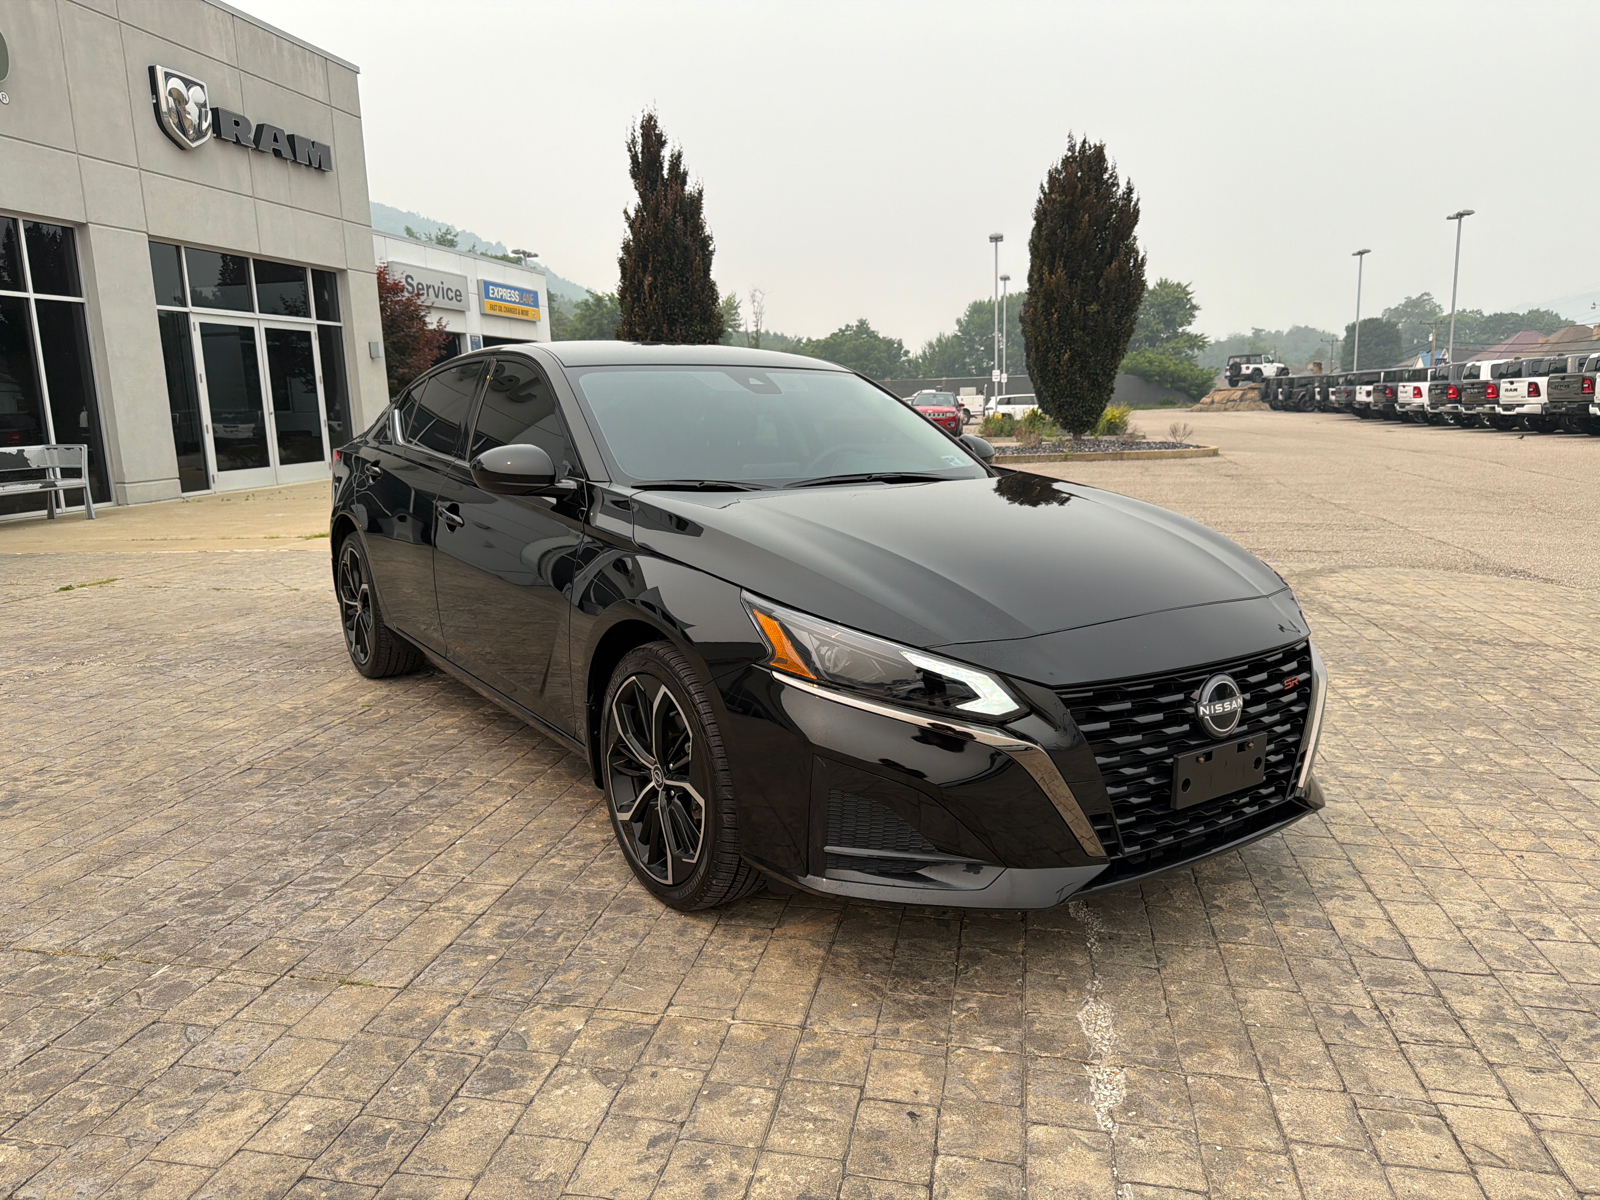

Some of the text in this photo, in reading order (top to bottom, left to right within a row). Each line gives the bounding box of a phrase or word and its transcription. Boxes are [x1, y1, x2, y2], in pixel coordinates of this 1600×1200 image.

[210, 107, 333, 172] RAM
[404, 274, 463, 303] Service
[1284, 676, 1299, 690] SR
[1200, 698, 1243, 716] NISSAN
